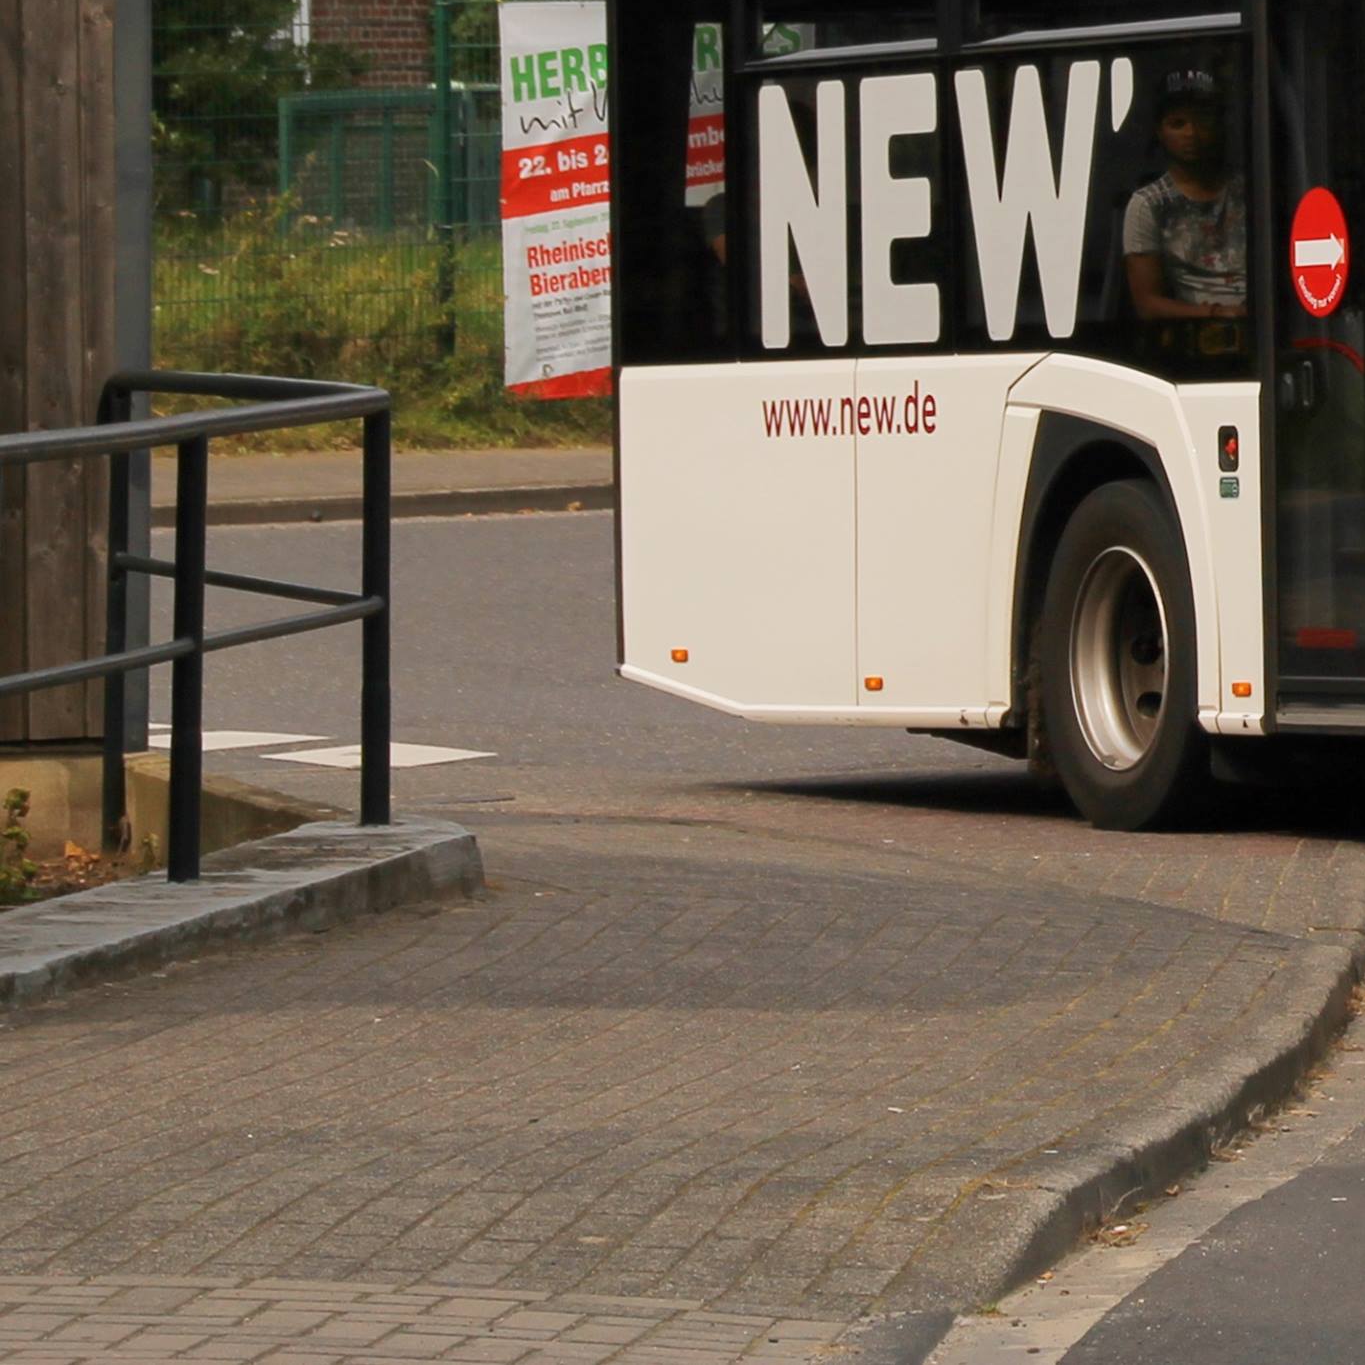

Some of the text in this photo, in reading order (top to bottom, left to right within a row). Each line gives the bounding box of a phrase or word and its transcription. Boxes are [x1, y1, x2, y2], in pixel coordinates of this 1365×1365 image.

[510, 42, 608, 103] HERB
[518, 144, 609, 180] 22. bis 2
[550, 187, 570, 203] am
[572, 180, 610, 199] Pfarrz
[530, 266, 614, 297] Bieraben
[762, 380, 937, 438] www.new.de
